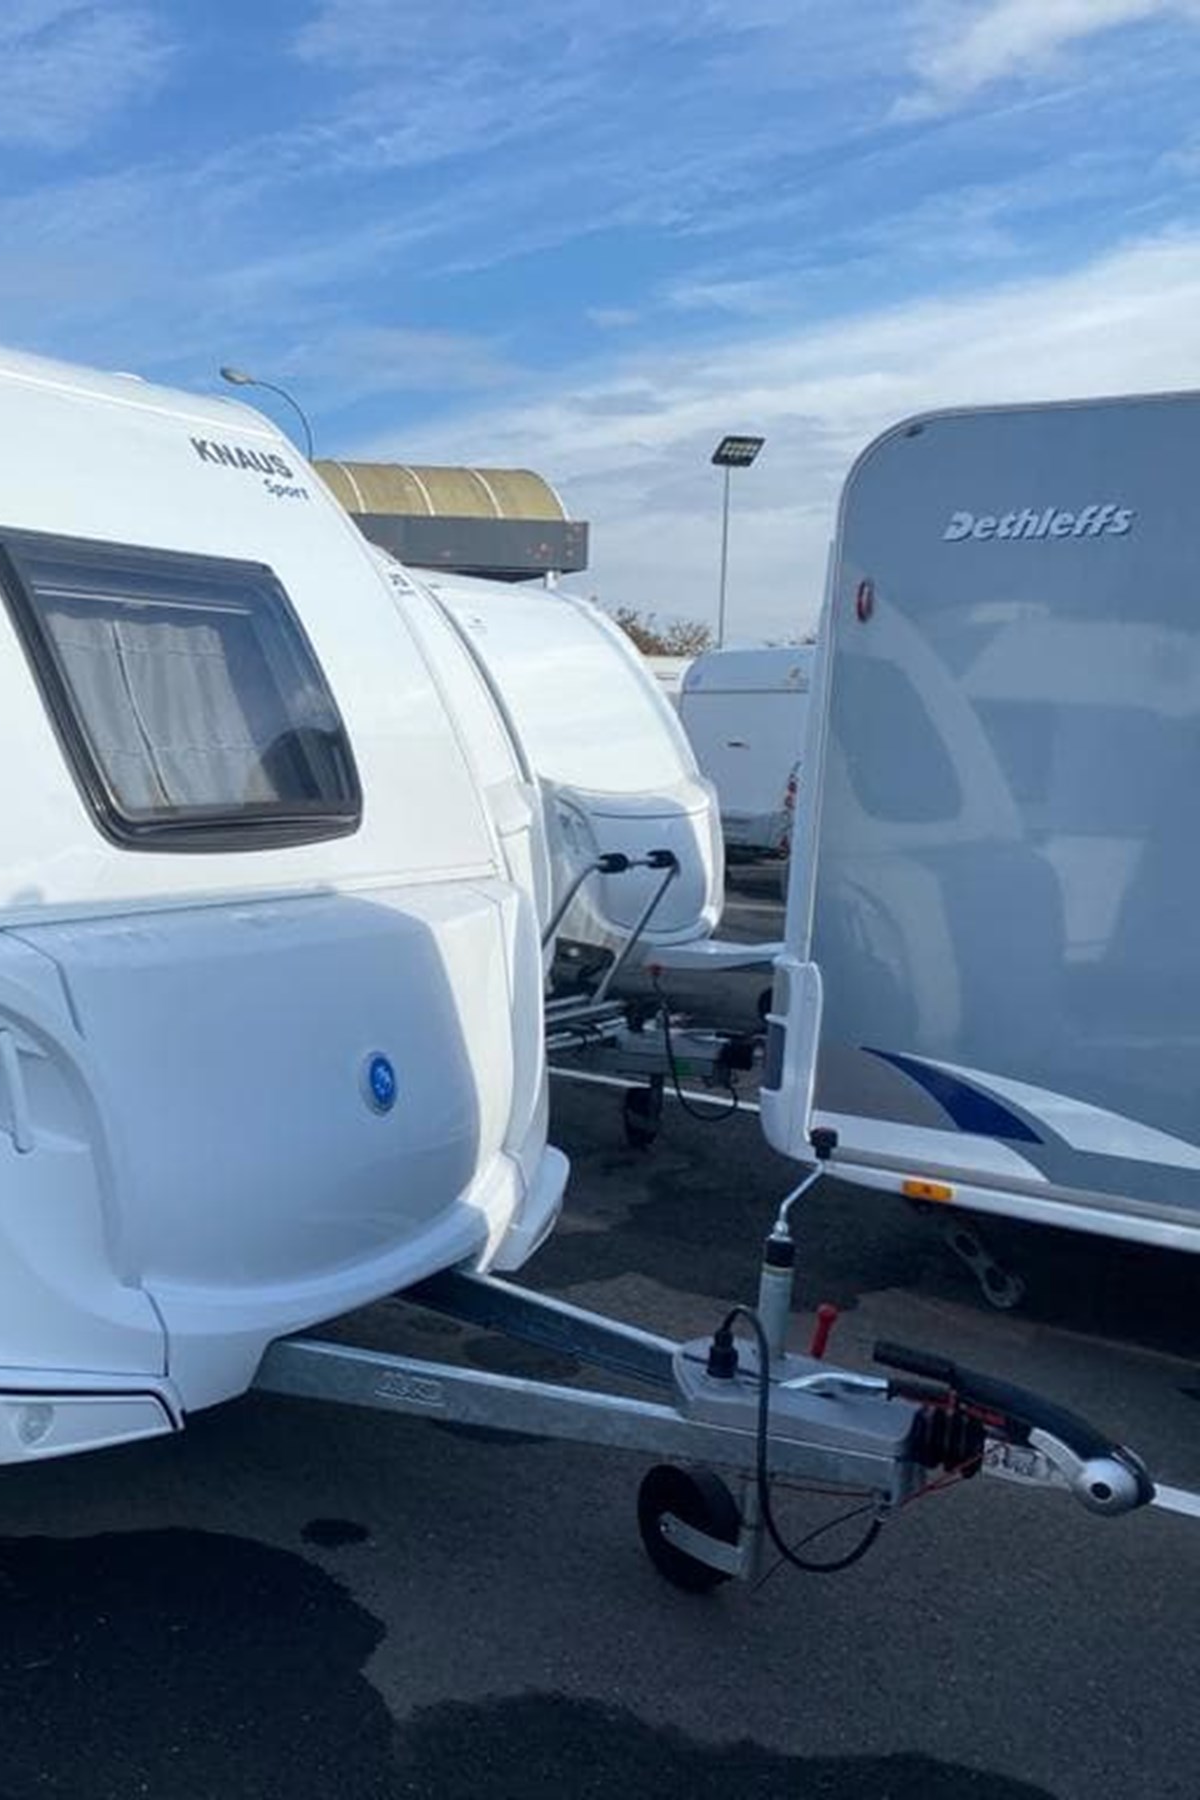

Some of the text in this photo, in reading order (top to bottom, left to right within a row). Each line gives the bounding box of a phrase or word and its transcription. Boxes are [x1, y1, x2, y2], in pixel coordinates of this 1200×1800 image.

[191, 437, 294, 479] KNAUS
[263, 479, 310, 501] Sport
[942, 504, 1134, 541] Dethleffs
